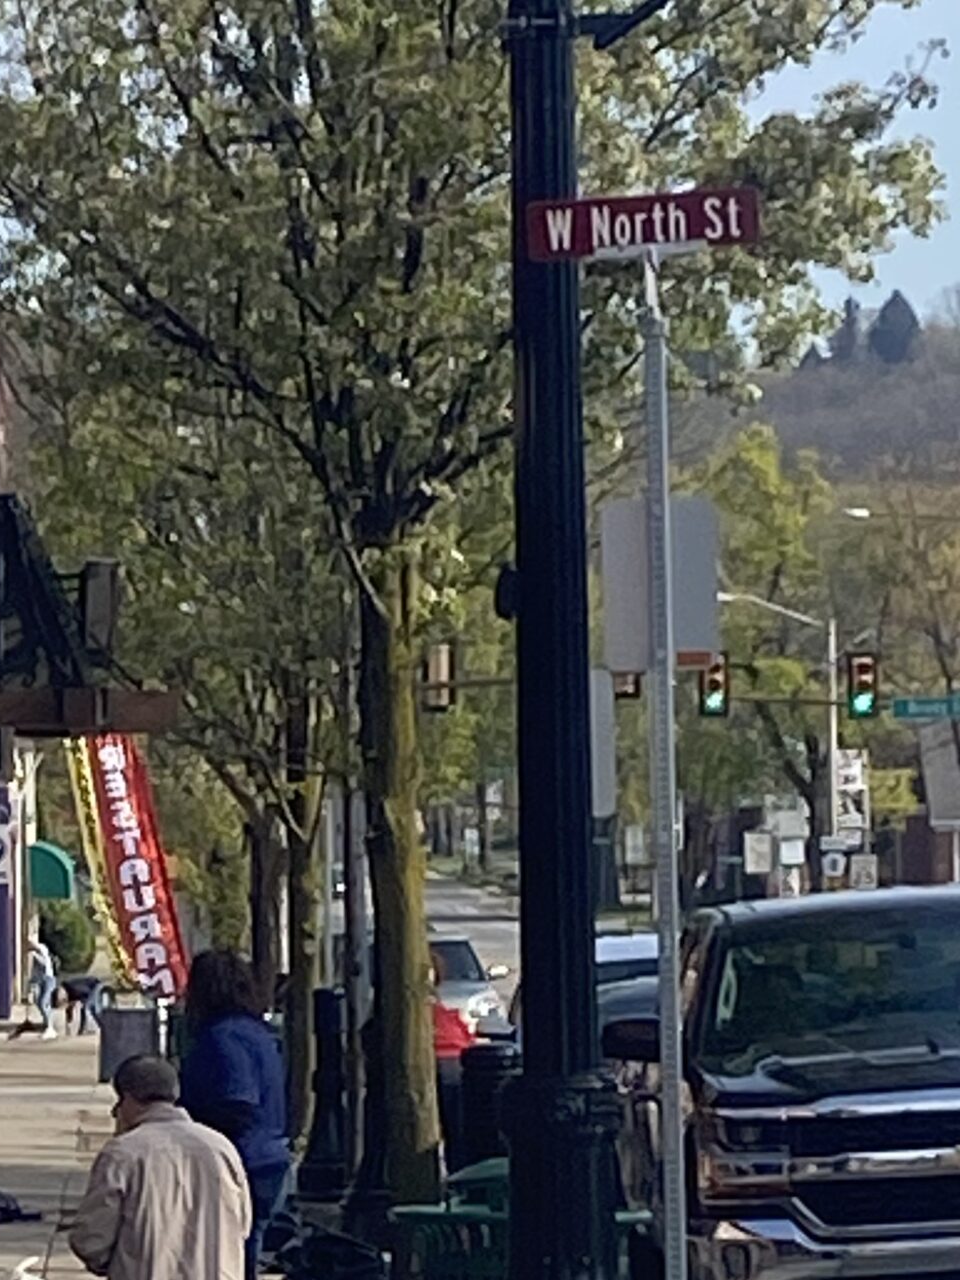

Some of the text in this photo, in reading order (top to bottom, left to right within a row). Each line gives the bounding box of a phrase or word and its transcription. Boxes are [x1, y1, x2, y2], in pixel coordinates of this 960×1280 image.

[545, 196, 741, 251] W North St
